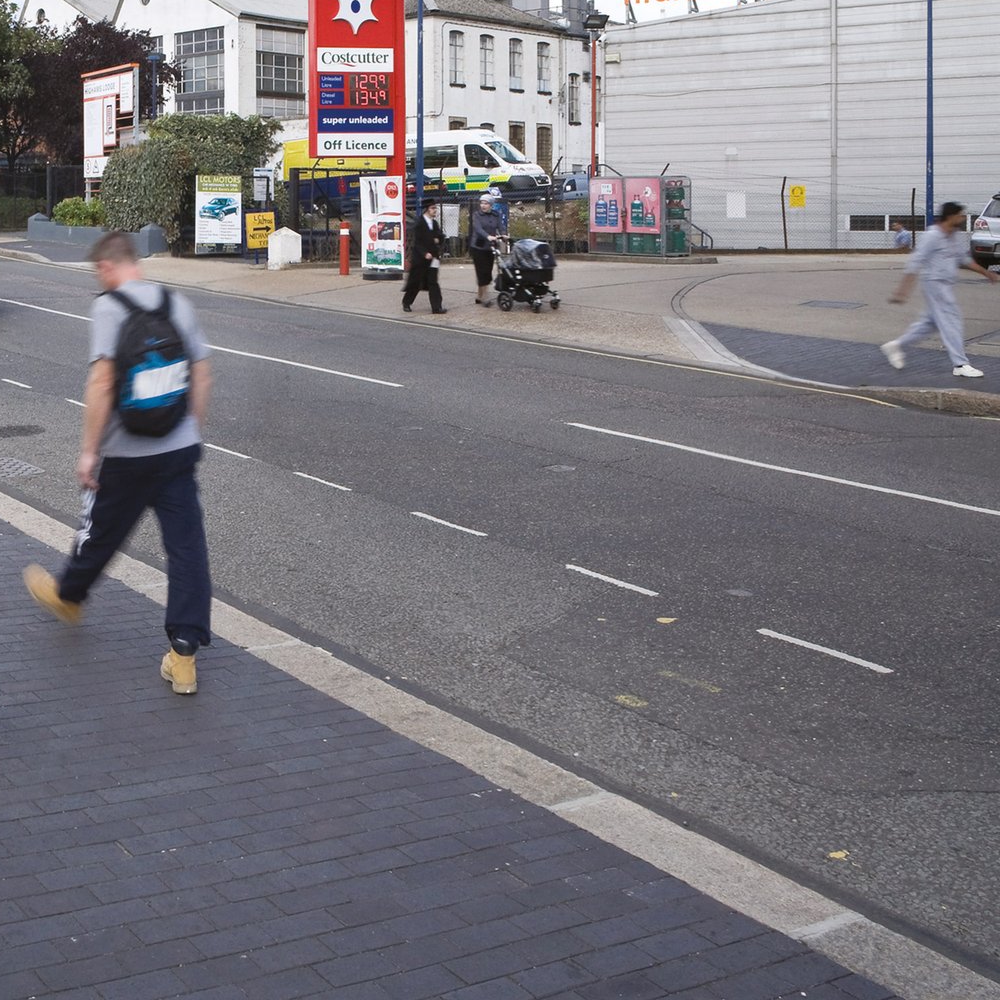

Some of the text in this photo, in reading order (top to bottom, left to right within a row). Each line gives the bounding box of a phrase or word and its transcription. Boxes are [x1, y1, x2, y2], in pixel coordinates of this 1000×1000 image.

[321, 51, 389, 65] Costcutter
[322, 115, 389, 126] super unleaded
[323, 139, 388, 150] Off Licence
[213, 175, 241, 184] MOTORS
